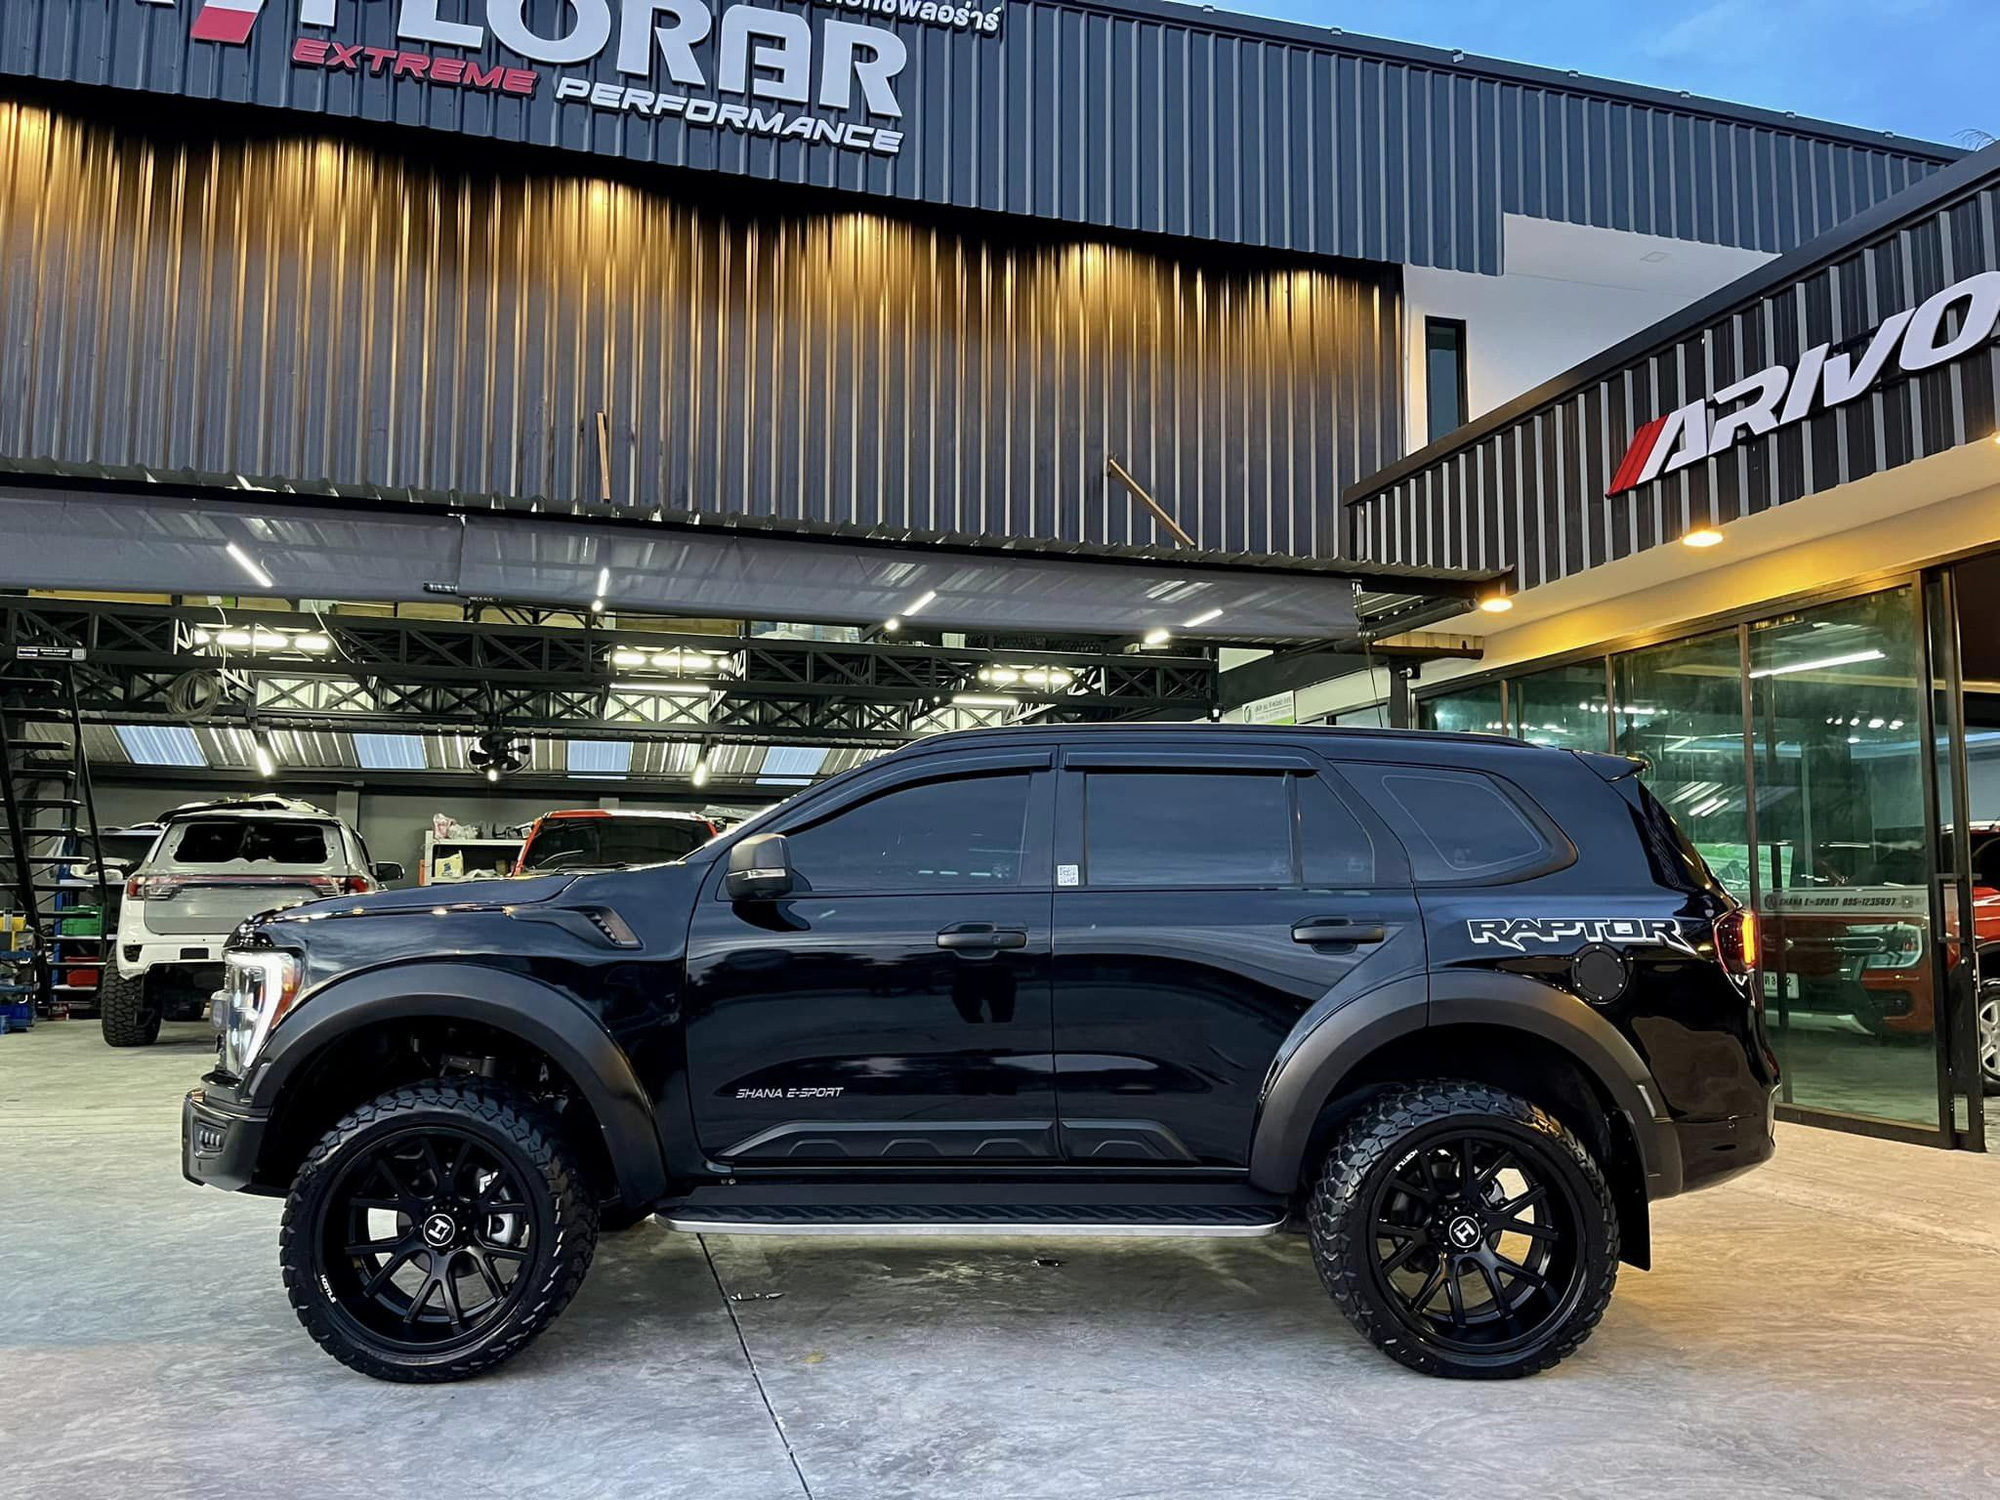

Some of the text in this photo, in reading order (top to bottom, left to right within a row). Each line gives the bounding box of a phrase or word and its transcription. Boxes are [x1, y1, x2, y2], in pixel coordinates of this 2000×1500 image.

[292, 39, 904, 153] EXTREME PERFORMANCE
[1467, 918, 1697, 955] RAPTOR
[736, 1086, 844, 1099] SHANA E-SPORT
